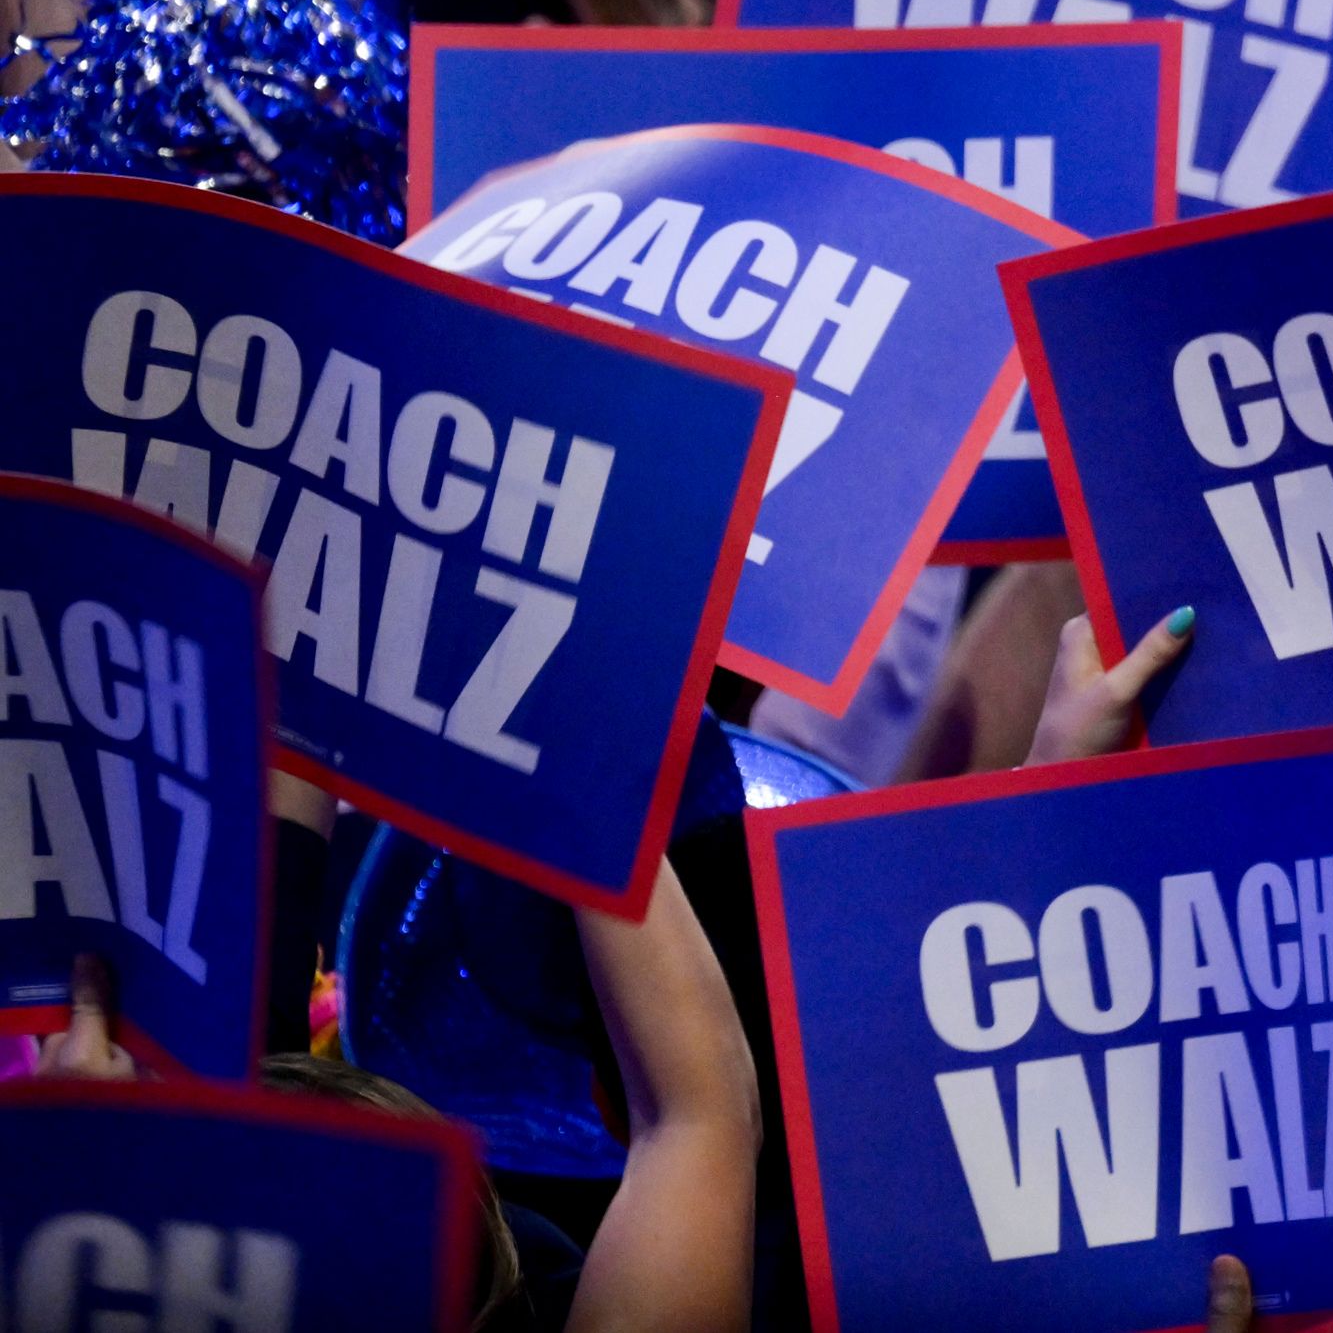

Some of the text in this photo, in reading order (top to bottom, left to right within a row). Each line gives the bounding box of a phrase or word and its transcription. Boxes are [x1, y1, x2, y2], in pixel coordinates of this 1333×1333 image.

[430, 191, 911, 396] COACH
[81, 289, 616, 584] COACH
[0, 589, 209, 780] ACH
[0, 738, 212, 987] ALZ
